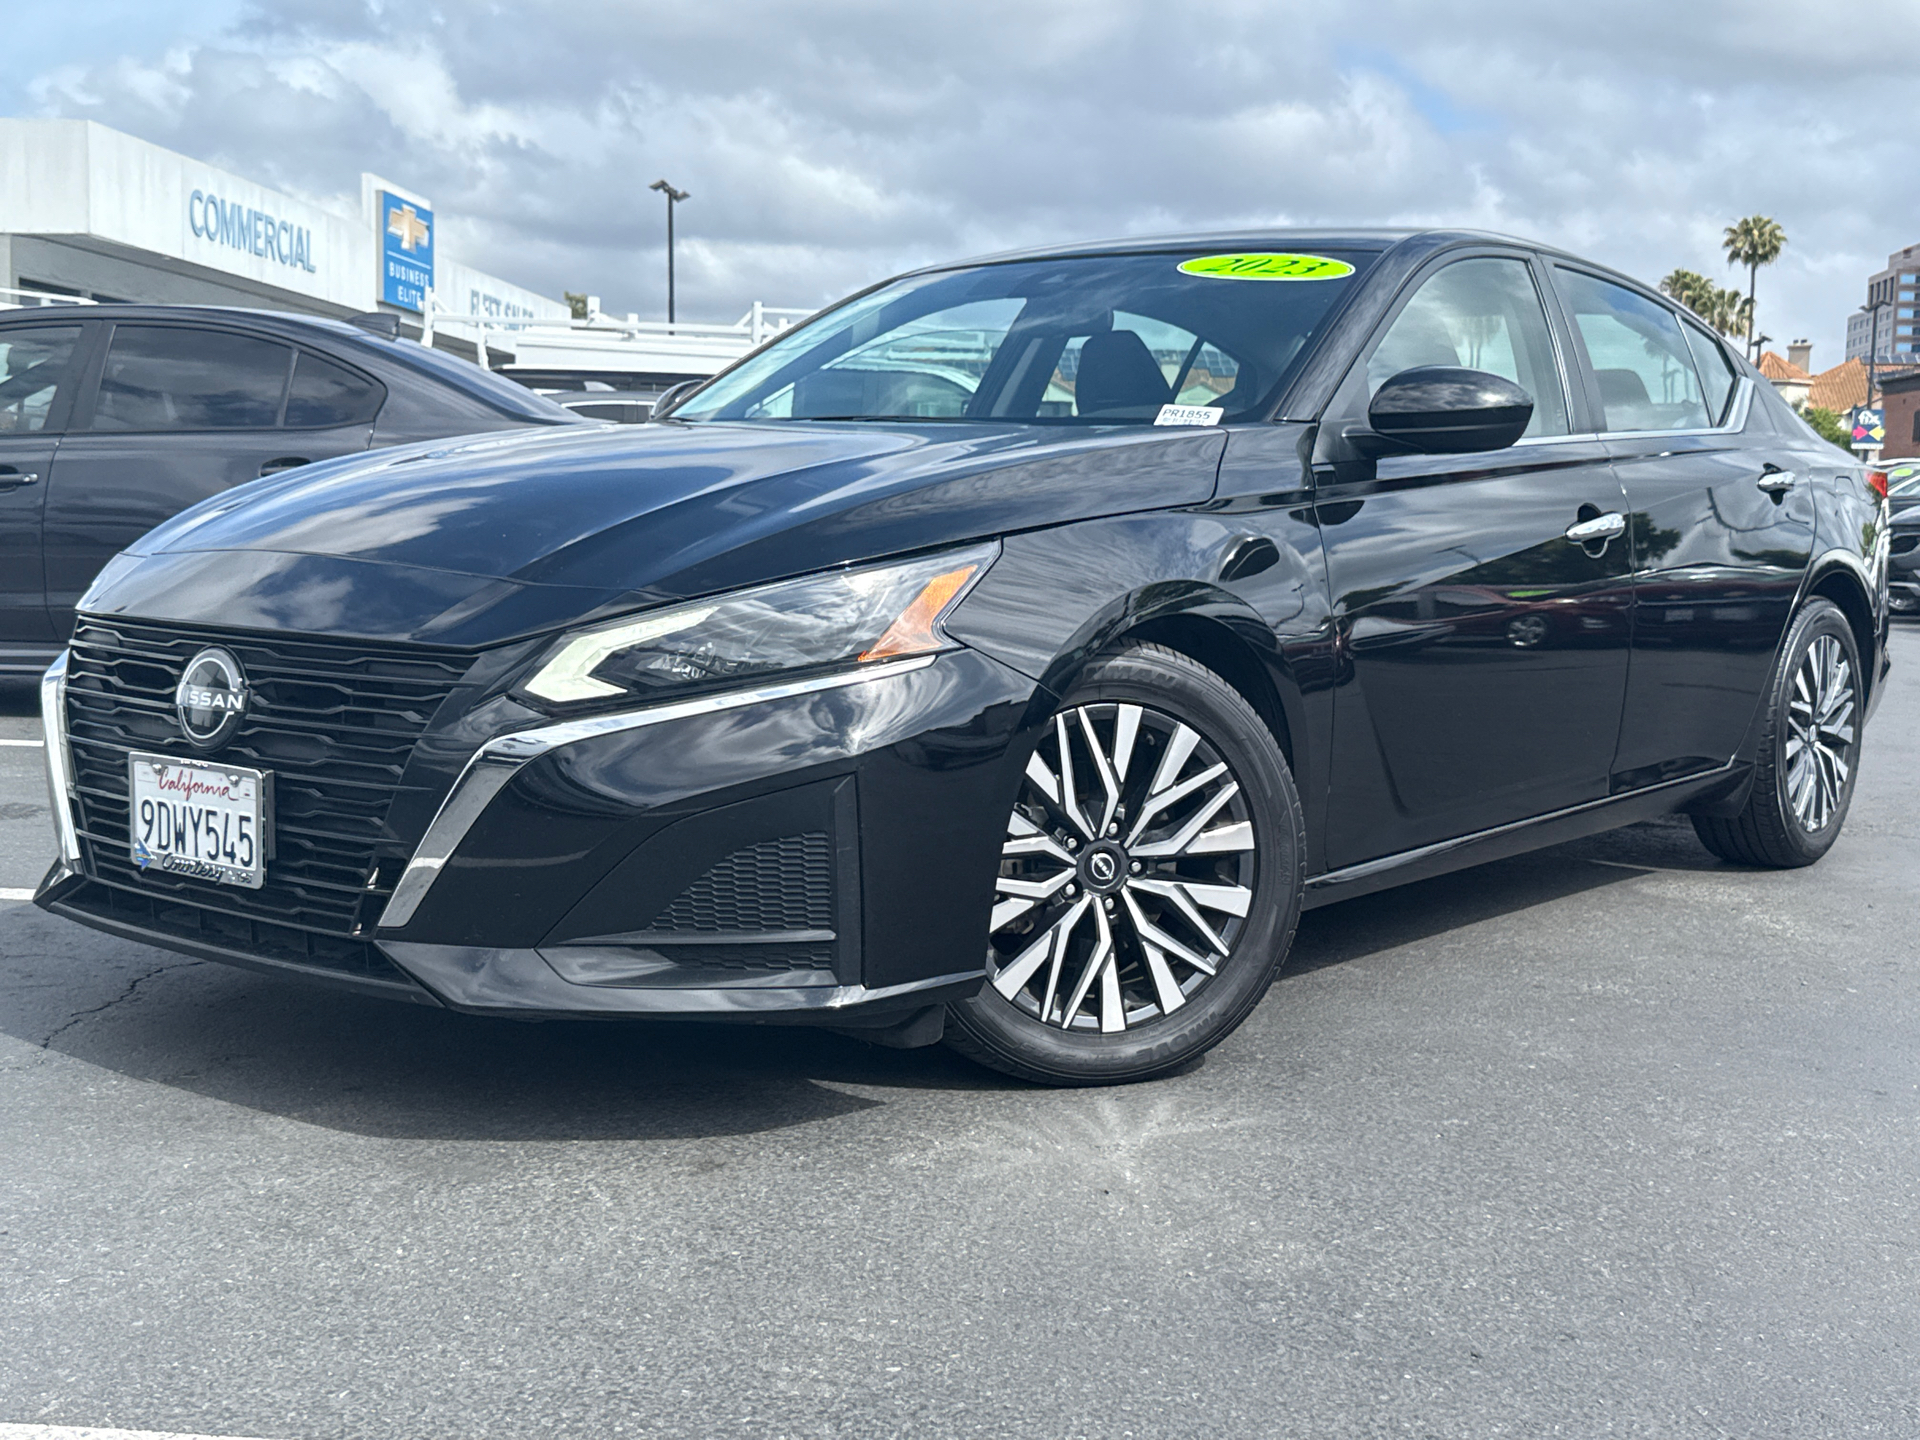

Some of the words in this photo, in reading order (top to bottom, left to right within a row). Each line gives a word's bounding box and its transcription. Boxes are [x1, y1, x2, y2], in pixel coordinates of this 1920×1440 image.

[189, 189, 317, 274] COMMERCIAL
[389, 261, 429, 287] BUSINESS
[1199, 259, 1329, 275] 2023
[1162, 408, 1212, 420] PR1855
[158, 766, 239, 801] California
[141, 799, 254, 868] 9DWY545
